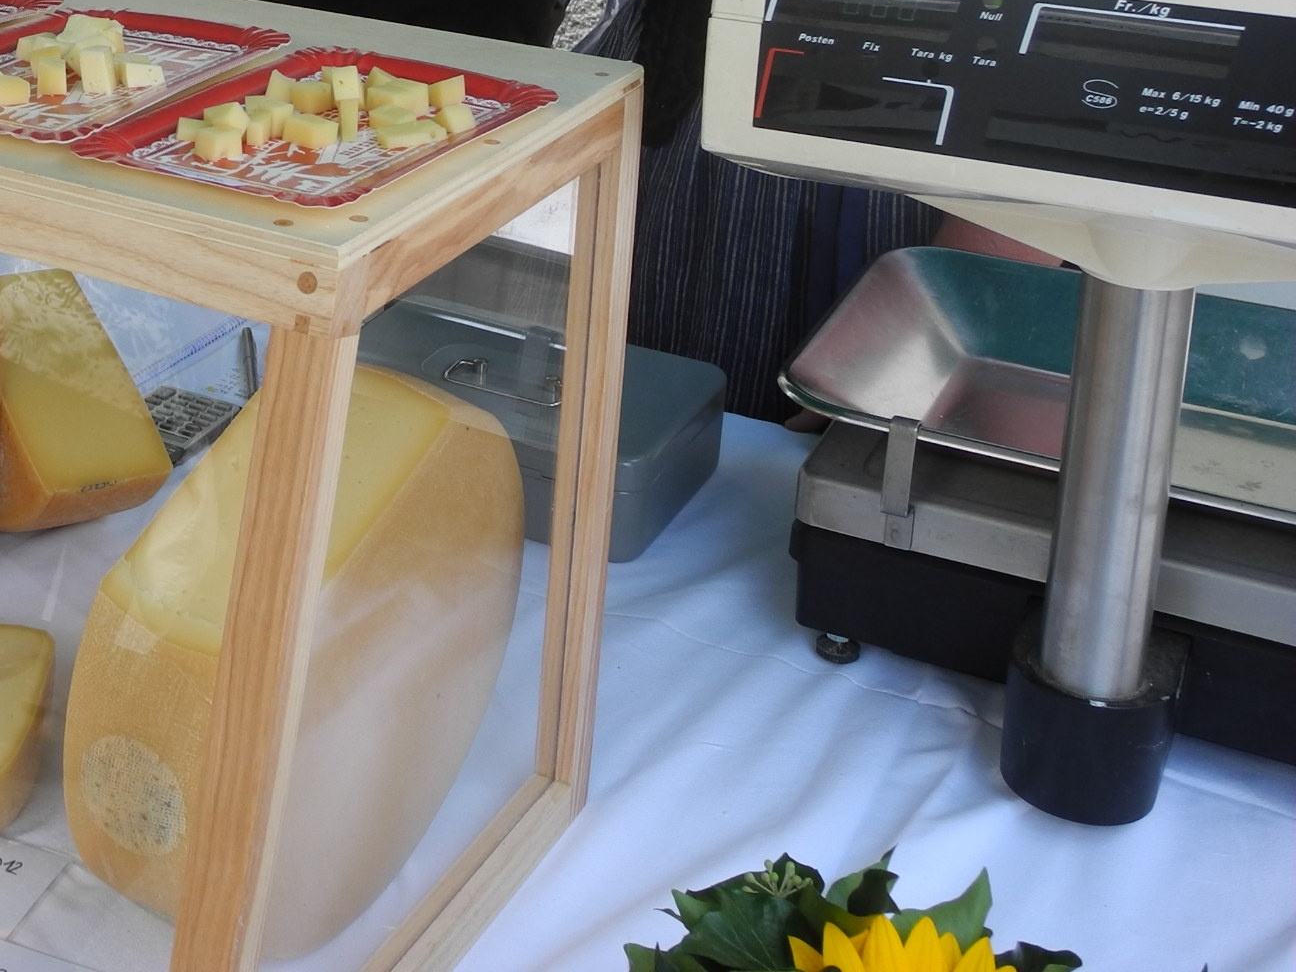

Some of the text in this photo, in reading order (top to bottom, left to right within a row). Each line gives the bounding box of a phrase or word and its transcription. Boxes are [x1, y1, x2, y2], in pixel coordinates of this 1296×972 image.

[979, 11, 1003, 22] Null
[1113, 0, 1171, 18] Fr./kg
[798, 32, 835, 46] Posten
[862, 41, 881, 52] Fix
[911, 47, 953, 63] Tara kg
[972, 56, 997, 67] Tara
[1141, 87, 1221, 108] Max 6/15 kg
[1139, 104, 1189, 121] e=2/5 g
[1238, 100, 1295, 118] Min 40 g
[1266, 121, 1283, 134] kg
